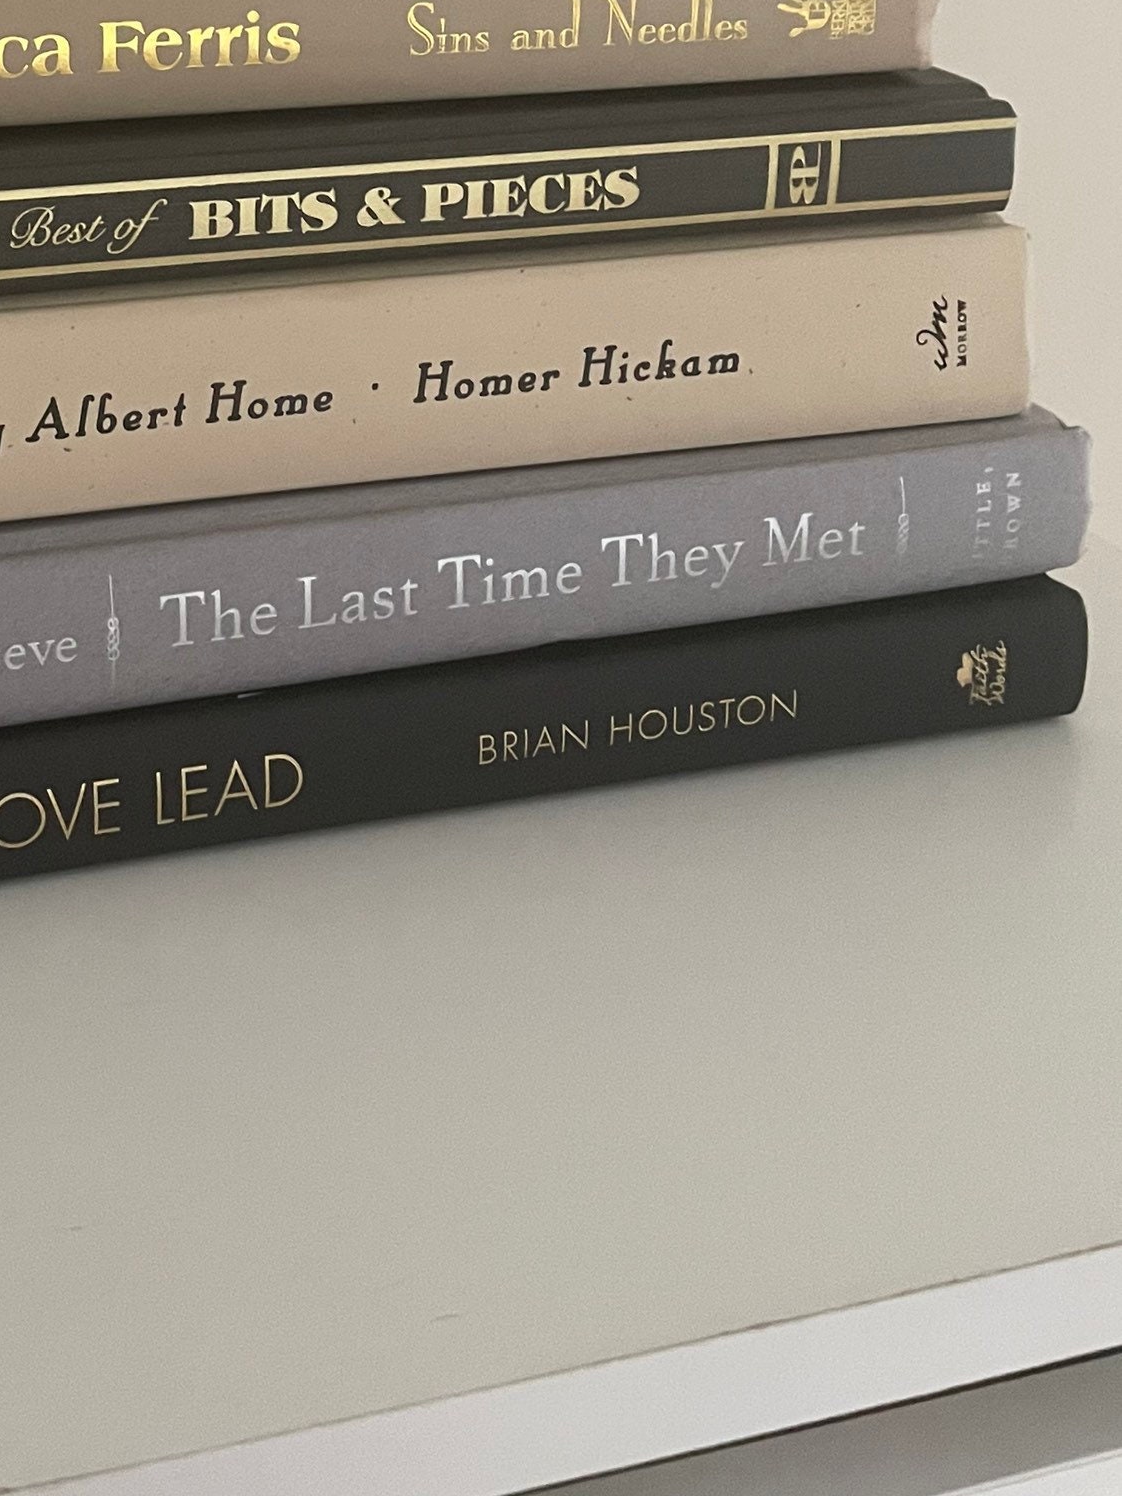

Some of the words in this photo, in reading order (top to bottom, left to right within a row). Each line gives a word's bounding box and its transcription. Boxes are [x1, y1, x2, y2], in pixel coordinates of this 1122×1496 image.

[96, 10, 301, 73] Ferris
[407, 2, 489, 55] Sins
[9, 206, 107, 250] Best
[107, 199, 167, 254] of
[188, 187, 338, 240] BITS
[357, 187, 405, 226] &
[420, 165, 640, 222] PIECES
[957, 300, 967, 367] MORROW
[413, 360, 560, 403] Homer
[578, 339, 739, 387] Hickam
[25, 393, 186, 443] Albert
[205, 380, 333, 423] Home
[160, 589, 277, 647] The
[297, 576, 418, 628] Last
[438, 555, 581, 608] Time
[601, 533, 744, 587] They
[764, 513, 865, 565] Met
[479, 720, 588, 764] BRIAN
[610, 690, 796, 745] HOUSTON
[156, 754, 303, 824] LEAD
